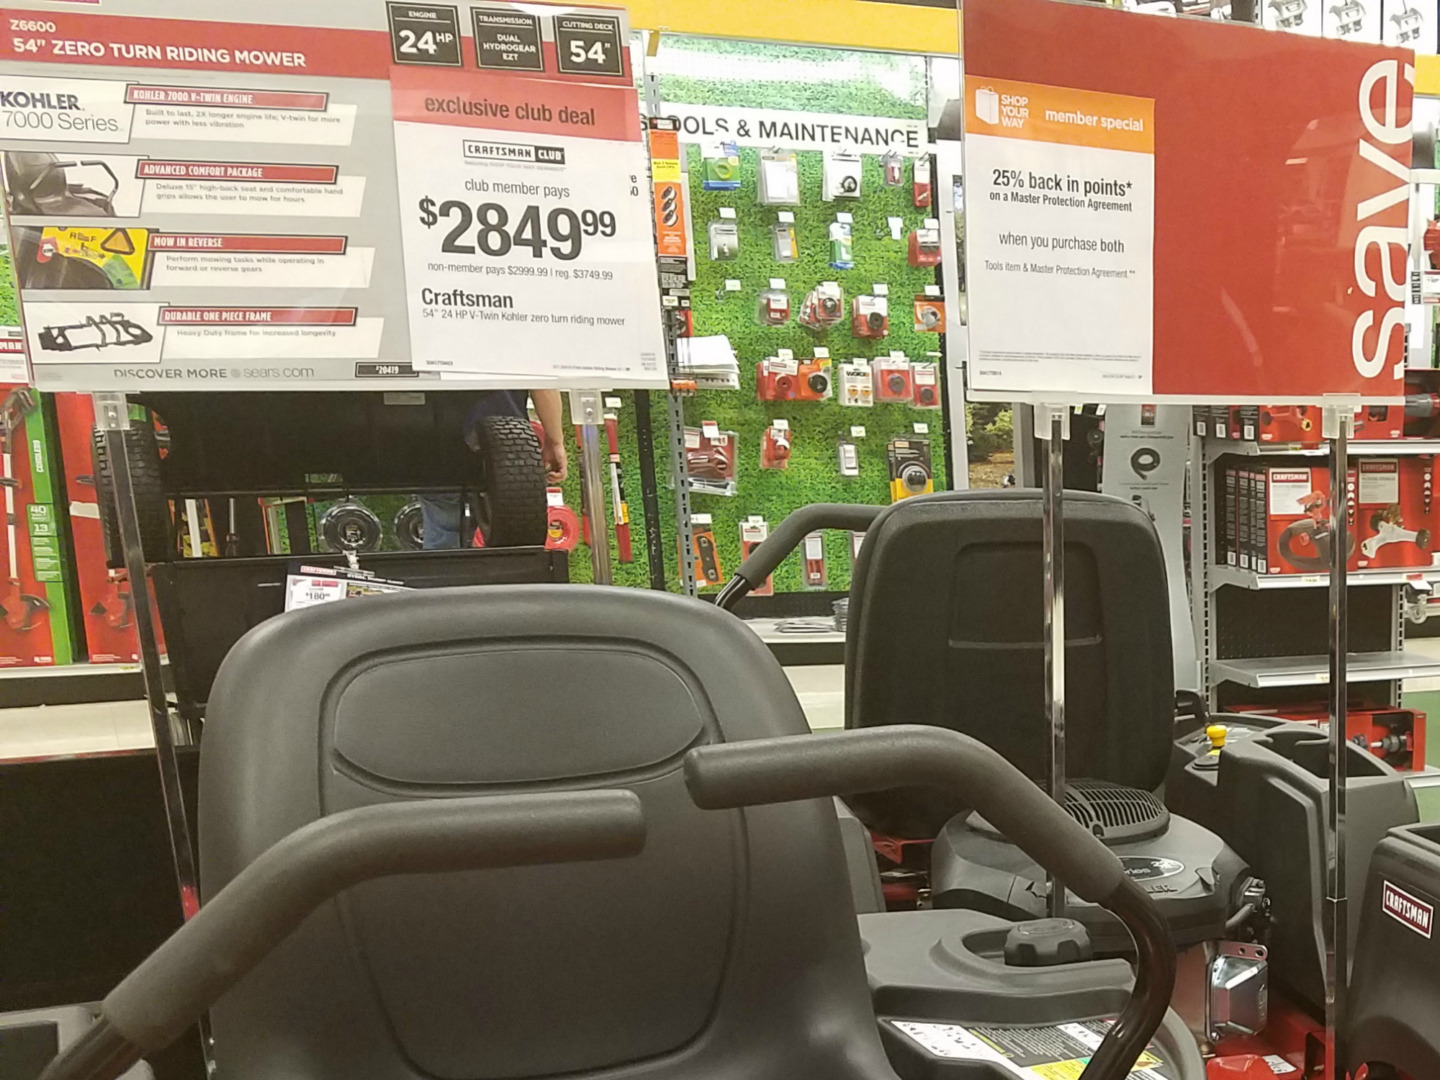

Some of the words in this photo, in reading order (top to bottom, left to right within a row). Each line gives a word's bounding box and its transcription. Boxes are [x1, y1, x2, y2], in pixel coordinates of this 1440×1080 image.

[408, 11, 437, 19] ENGINE
[479, 15, 533, 25] TRANSMISSION
[10, 19, 56, 33] Z6600
[562, 20, 593, 29] CUTTING
[594, 22, 614, 30] DECK
[497, 34, 521, 43] DUAL
[13, 38, 46, 53] 54"
[52, 40, 105, 57] ZERO
[109, 43, 162, 60] TURN
[166, 46, 230, 63] RIDING
[234, 49, 307, 68] MOWER
[483, 43, 536, 53] HYDROGEAR
[570, 41, 611, 64] 54"
[502, 53, 519, 61] EZT
[133, 90, 165, 101] KOHLER
[167, 91, 188, 102] 7000
[190, 92, 222, 103] V-TWIN
[223, 94, 253, 105] ENGINE
[1001, 94, 1028, 106] SHOP
[424, 95, 510, 119] exclusive
[515, 102, 553, 122] club
[557, 106, 596, 126] deal
[1001, 106, 1029, 118] YOUR
[2, 110, 53, 129] 7000
[58, 113, 119, 132] Series
[1002, 117, 1024, 128] WAY
[1045, 109, 1098, 126] member
[1101, 116, 1143, 132] special
[737, 120, 752, 138] &
[759, 120, 920, 148] MAINTENANCE
[467, 145, 532, 159] CRAFTSMAN
[538, 148, 563, 160] CLUB
[143, 164, 186, 176] ADVANCED
[188, 165, 225, 177] COMFORT
[226, 167, 264, 178] PACKAGE
[993, 168, 1024, 188] 25%
[1029, 171, 1062, 191] back
[1067, 175, 1079, 192] in
[464, 178, 490, 193] club
[492, 181, 540, 196] member
[543, 184, 570, 200] pays
[990, 191, 1000, 201] on
[1003, 193, 1008, 201] a
[1011, 191, 1040, 204] Master
[1043, 195, 1085, 208] Protection
[1087, 199, 1132, 212] Agreement
[1352, 58, 1414, 381] save
[154, 237, 175, 247] MOW
[177, 237, 186, 247] IN
[188, 238, 223, 248] REVERSE
[999, 232, 1027, 246] when
[1031, 236, 1048, 249] you
[1052, 237, 1097, 251] purchase
[1100, 239, 1124, 253] both
[427, 261, 483, 274] non-member
[485, 265, 506, 277] pays
[507, 266, 549, 278] $2999.99
[573, 269, 614, 280] $3749.99
[985, 260, 1003, 271] Tools
[1005, 261, 1020, 272] item
[1023, 263, 1028, 272] &
[1031, 263, 1054, 274] Master
[1056, 265, 1090, 276] Protection
[421, 287, 514, 309] Craftsman
[164, 311, 201, 321] DURABLE
[203, 312, 219, 321] ONE
[221, 312, 244, 321] PIECE
[245, 312, 272, 321] FRAME
[441, 309, 453, 319] 24
[455, 310, 468, 320] HP
[469, 311, 499, 321] V-Twin
[501, 311, 528, 322] Kohler
[530, 314, 549, 323] zero
[551, 314, 568, 324] turn
[570, 314, 594, 326] riding
[596, 316, 625, 326] mower
[114, 368, 182, 380] DISCOVER
[186, 368, 227, 379] MORE
[30, 505, 47, 514] 40
[34, 523, 48, 532] 13
[1386, 889, 1429, 929] CRAFTSMAN
